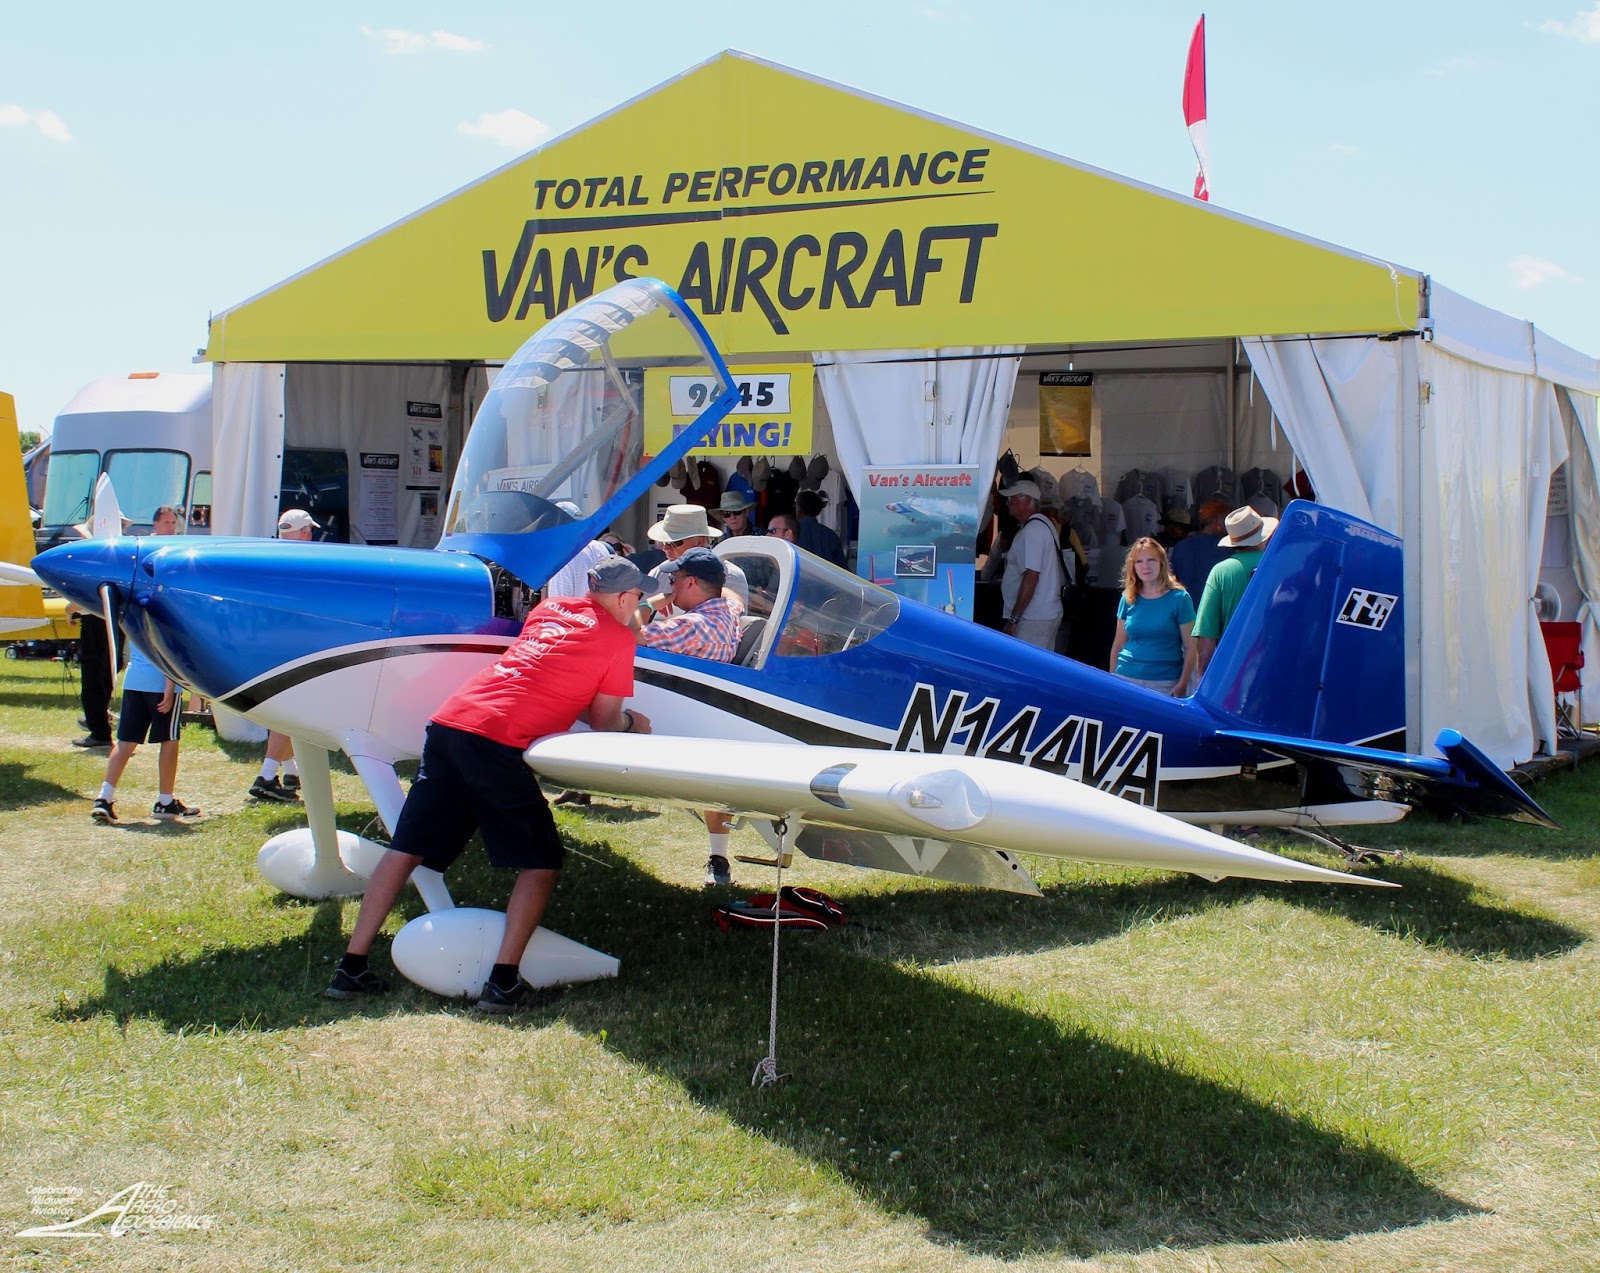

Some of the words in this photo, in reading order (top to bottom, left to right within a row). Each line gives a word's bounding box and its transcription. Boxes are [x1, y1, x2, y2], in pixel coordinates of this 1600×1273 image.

[534, 174, 649, 210] TOTAL
[661, 148, 990, 204] PERFORMANCE
[482, 222, 649, 323] VAN'S
[669, 223, 999, 335] AIRCRAFT
[1060, 375, 1090, 383] AIRCRAFT
[868, 474, 910, 487] Van's
[912, 472, 973, 487] Aircraft
[543, 600, 596, 628] VOLUNTEER
[891, 682, 1163, 811] N144VA
